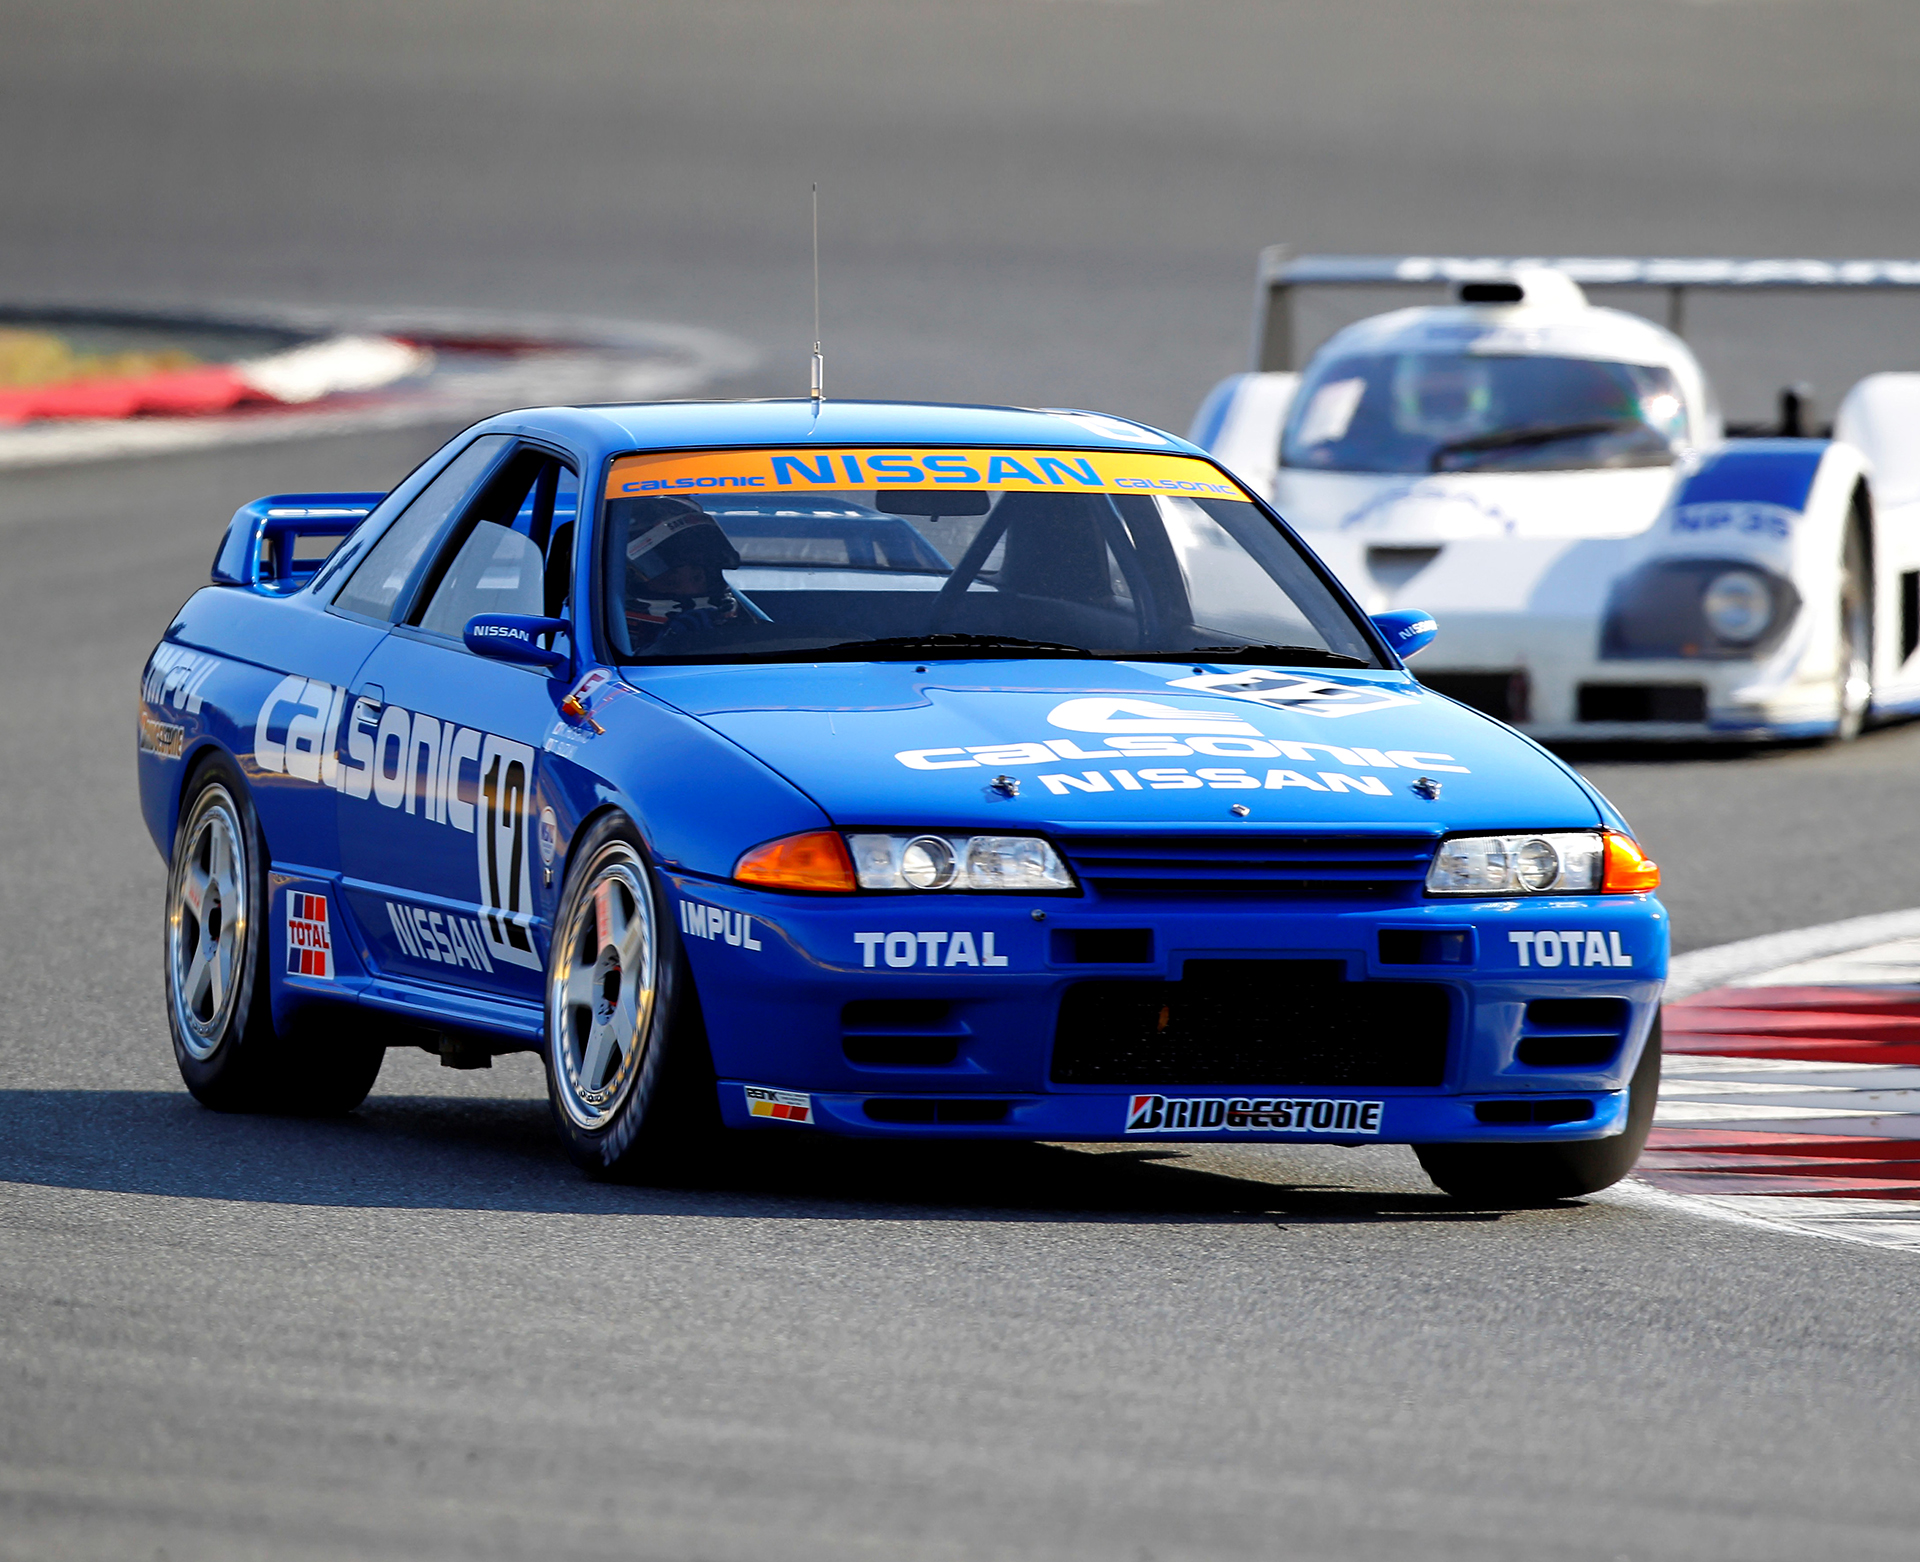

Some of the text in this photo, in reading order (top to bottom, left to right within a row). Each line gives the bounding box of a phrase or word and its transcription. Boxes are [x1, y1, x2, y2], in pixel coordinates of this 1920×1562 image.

[770, 455, 1106, 487] NISSAN
[473, 625, 529, 642] NISSAN
[1037, 768, 1394, 797] NISSAN
[288, 920, 330, 950] TOTAL
[385, 902, 494, 974] NISSAN
[679, 899, 762, 951] IMPUL
[854, 931, 1009, 968] TOTAL
[1508, 930, 1632, 967] TOTAL
[1126, 1094, 1384, 1134] BRIDGESTONE
